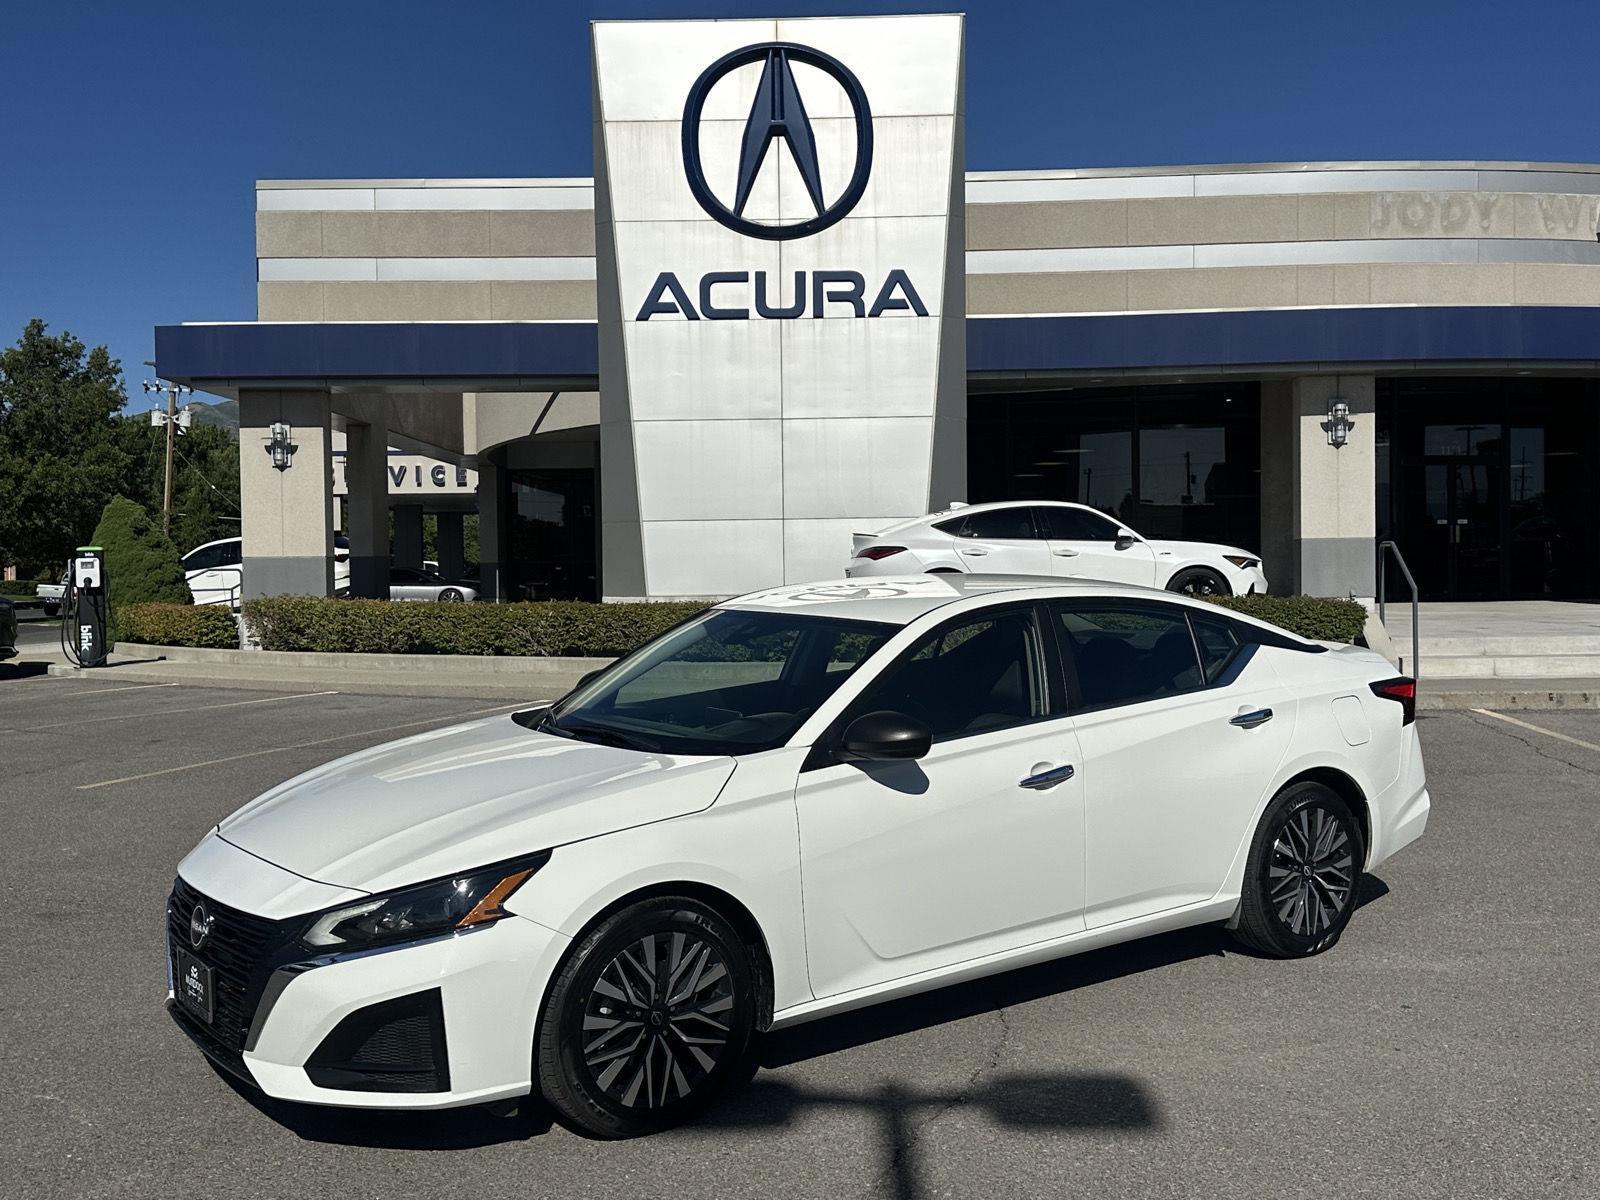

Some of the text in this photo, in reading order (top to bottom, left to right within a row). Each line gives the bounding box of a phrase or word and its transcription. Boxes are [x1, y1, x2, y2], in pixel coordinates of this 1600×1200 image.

[1371, 193, 1498, 234] JODY
[636, 269, 929, 321] ACURA
[81, 625, 92, 651] blink
